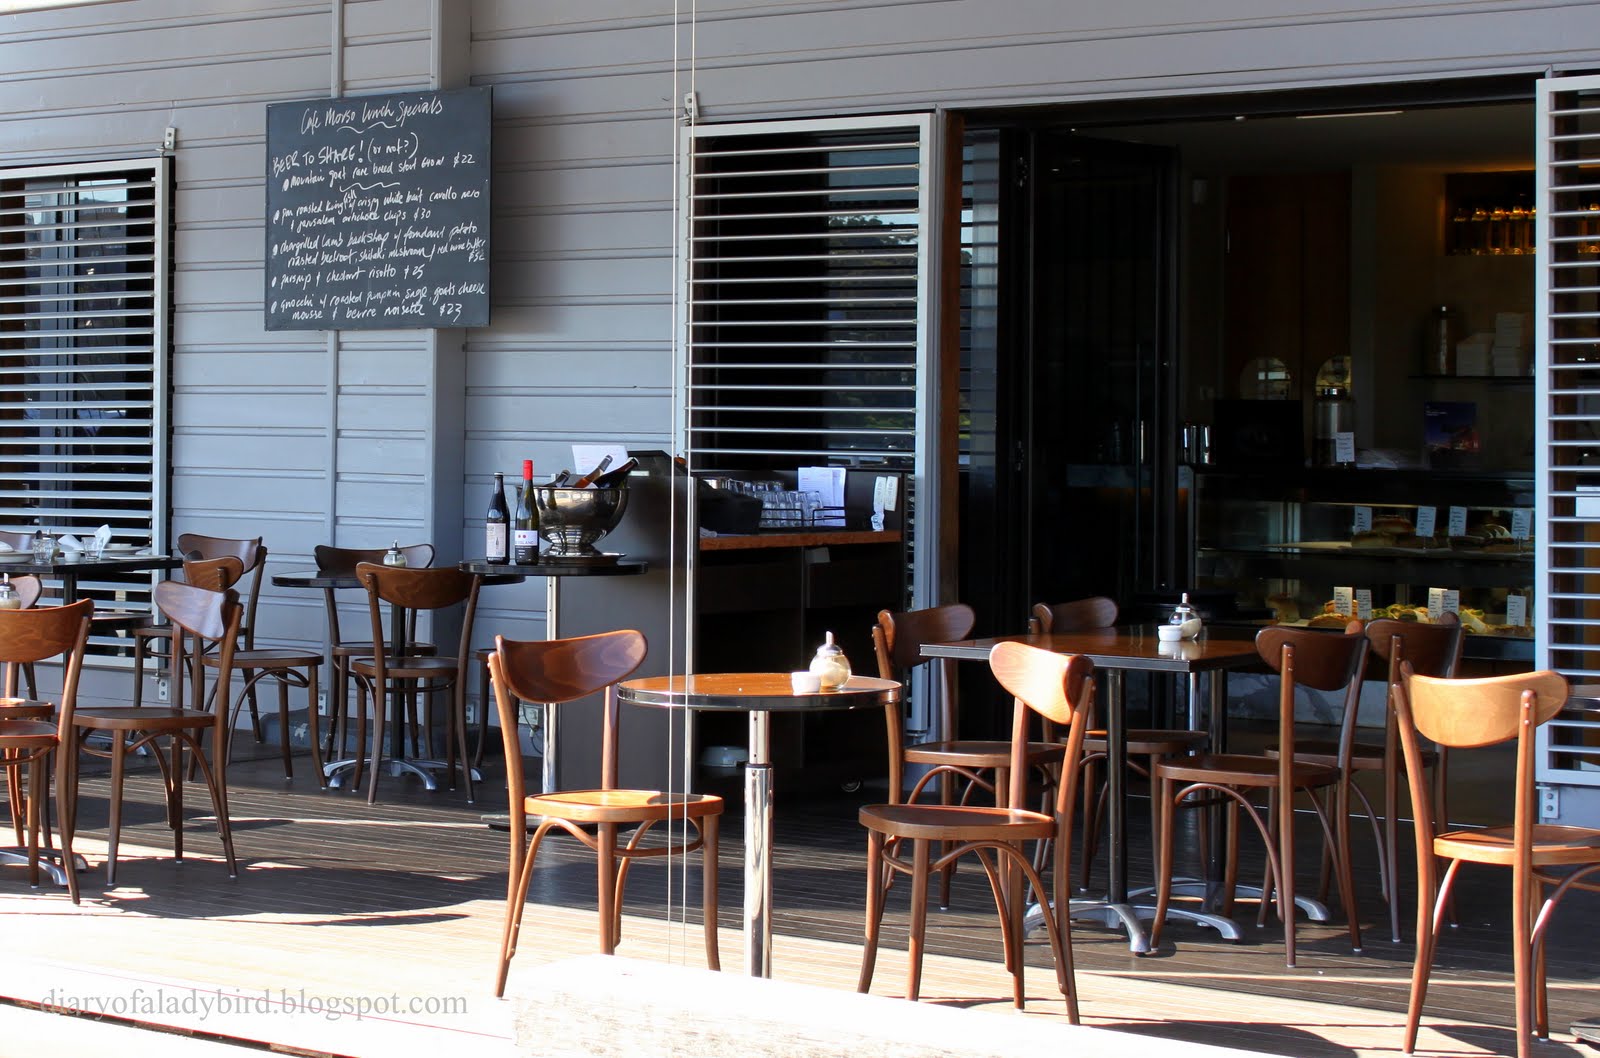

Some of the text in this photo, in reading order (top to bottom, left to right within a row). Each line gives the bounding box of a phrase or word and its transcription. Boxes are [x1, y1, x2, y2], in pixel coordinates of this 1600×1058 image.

[272, 150, 300, 178] BEER
[328, 166, 346, 188] goat
[398, 157, 417, 173] stout
[453, 151, 476, 168] $22
[383, 210, 407, 226] chips
[413, 207, 431, 221] $30
[368, 263, 396, 279] risotto
[439, 303, 463, 323] $23
